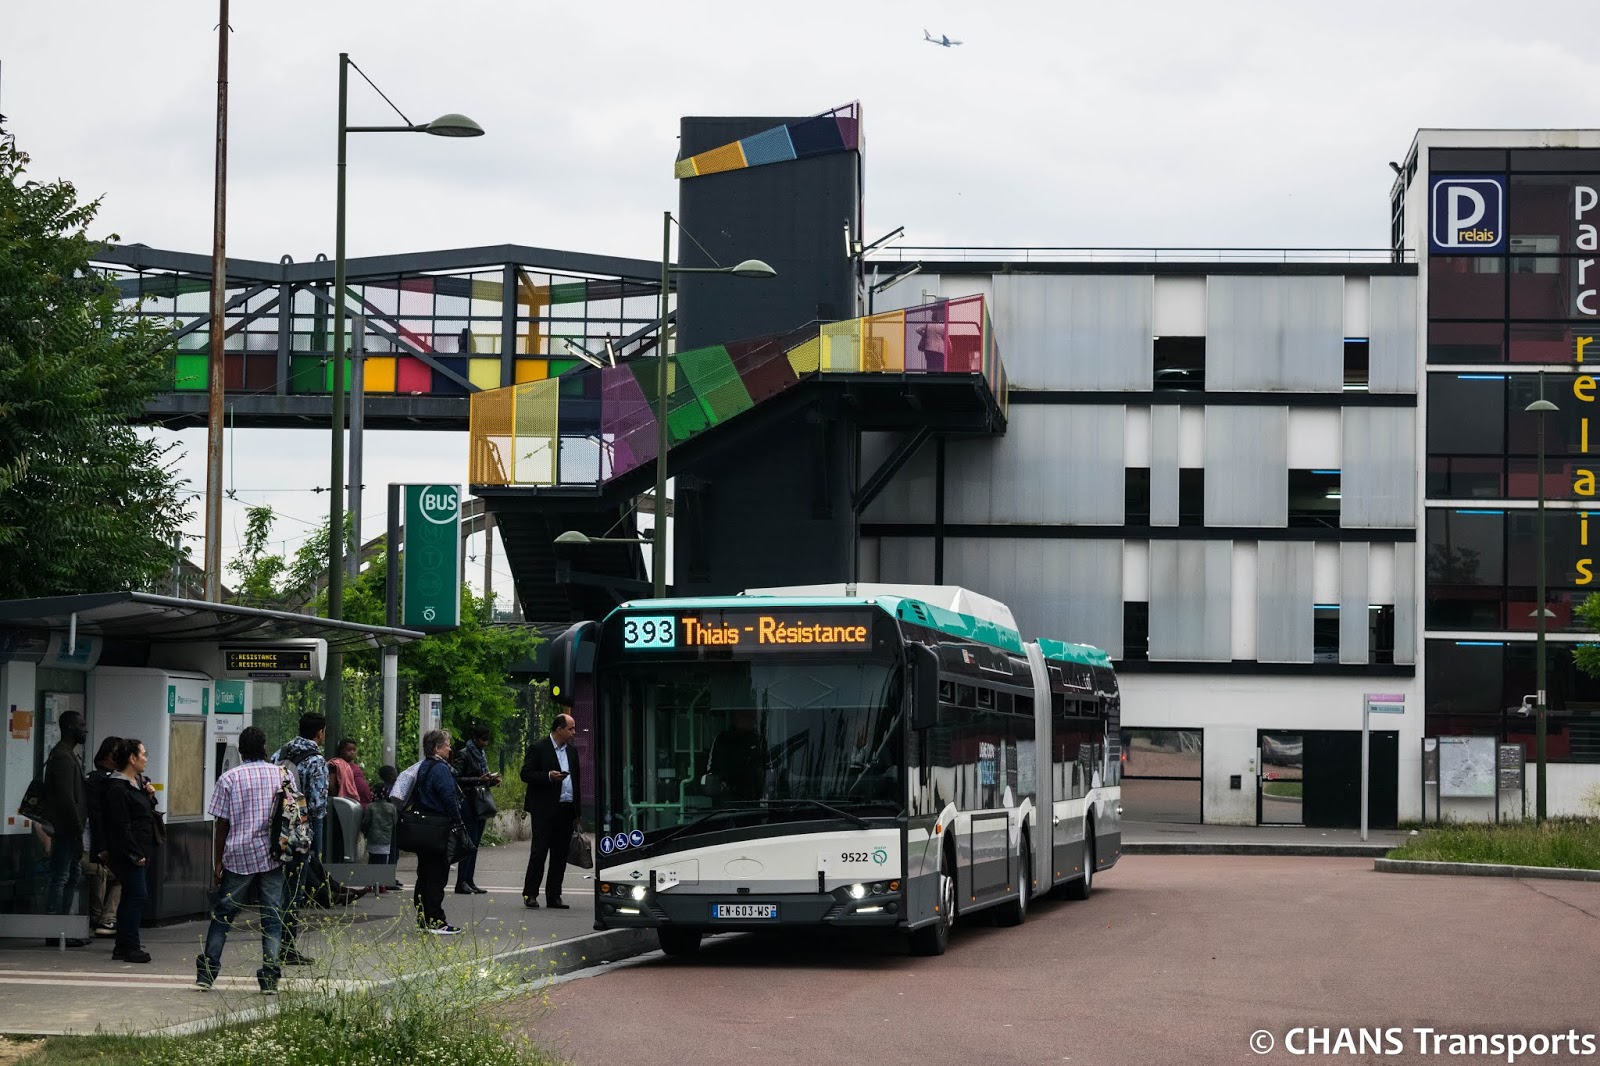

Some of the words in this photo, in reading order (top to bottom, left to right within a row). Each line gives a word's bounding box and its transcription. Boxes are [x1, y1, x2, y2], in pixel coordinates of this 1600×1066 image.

[1448, 186, 1485, 247] P
[1459, 228, 1494, 242] relais
[1573, 336, 1597, 585] relais
[425, 494, 457, 510] BUS
[625, 620, 673, 644] 393
[682, 617, 739, 645] Thiais
[759, 616, 867, 644] Résistance
[841, 852, 869, 863] 9522
